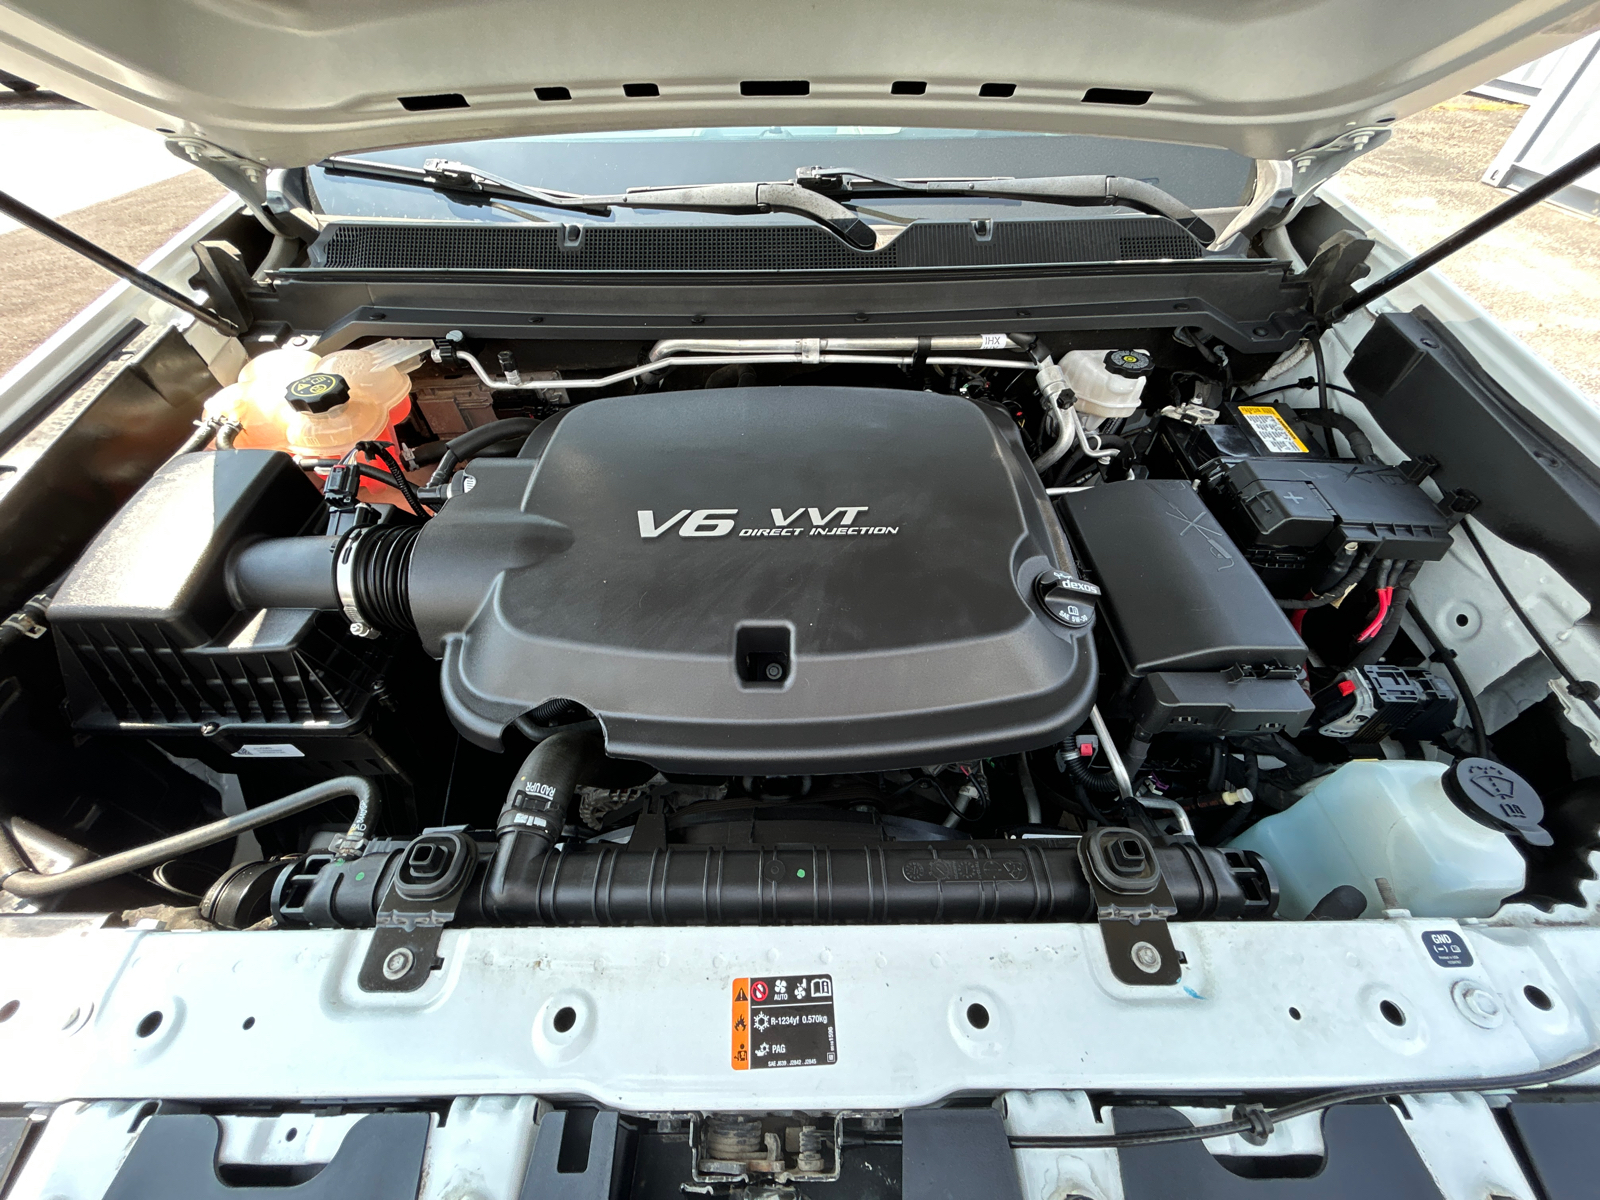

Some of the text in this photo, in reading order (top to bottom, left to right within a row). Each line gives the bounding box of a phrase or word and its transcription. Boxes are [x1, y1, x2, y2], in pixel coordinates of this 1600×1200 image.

[637, 506, 869, 538] V6 VVT
[738, 526, 899, 537] DIRECT INJECTION
[1061, 579, 1098, 593] dexos
[525, 781, 557, 797] RAD UPR
[1431, 933, 1452, 944] GND
[773, 993, 788, 1001] AUTO
[770, 1014, 828, 1026] R-1234yf 0.570kg
[771, 1044, 786, 1054] PAG
